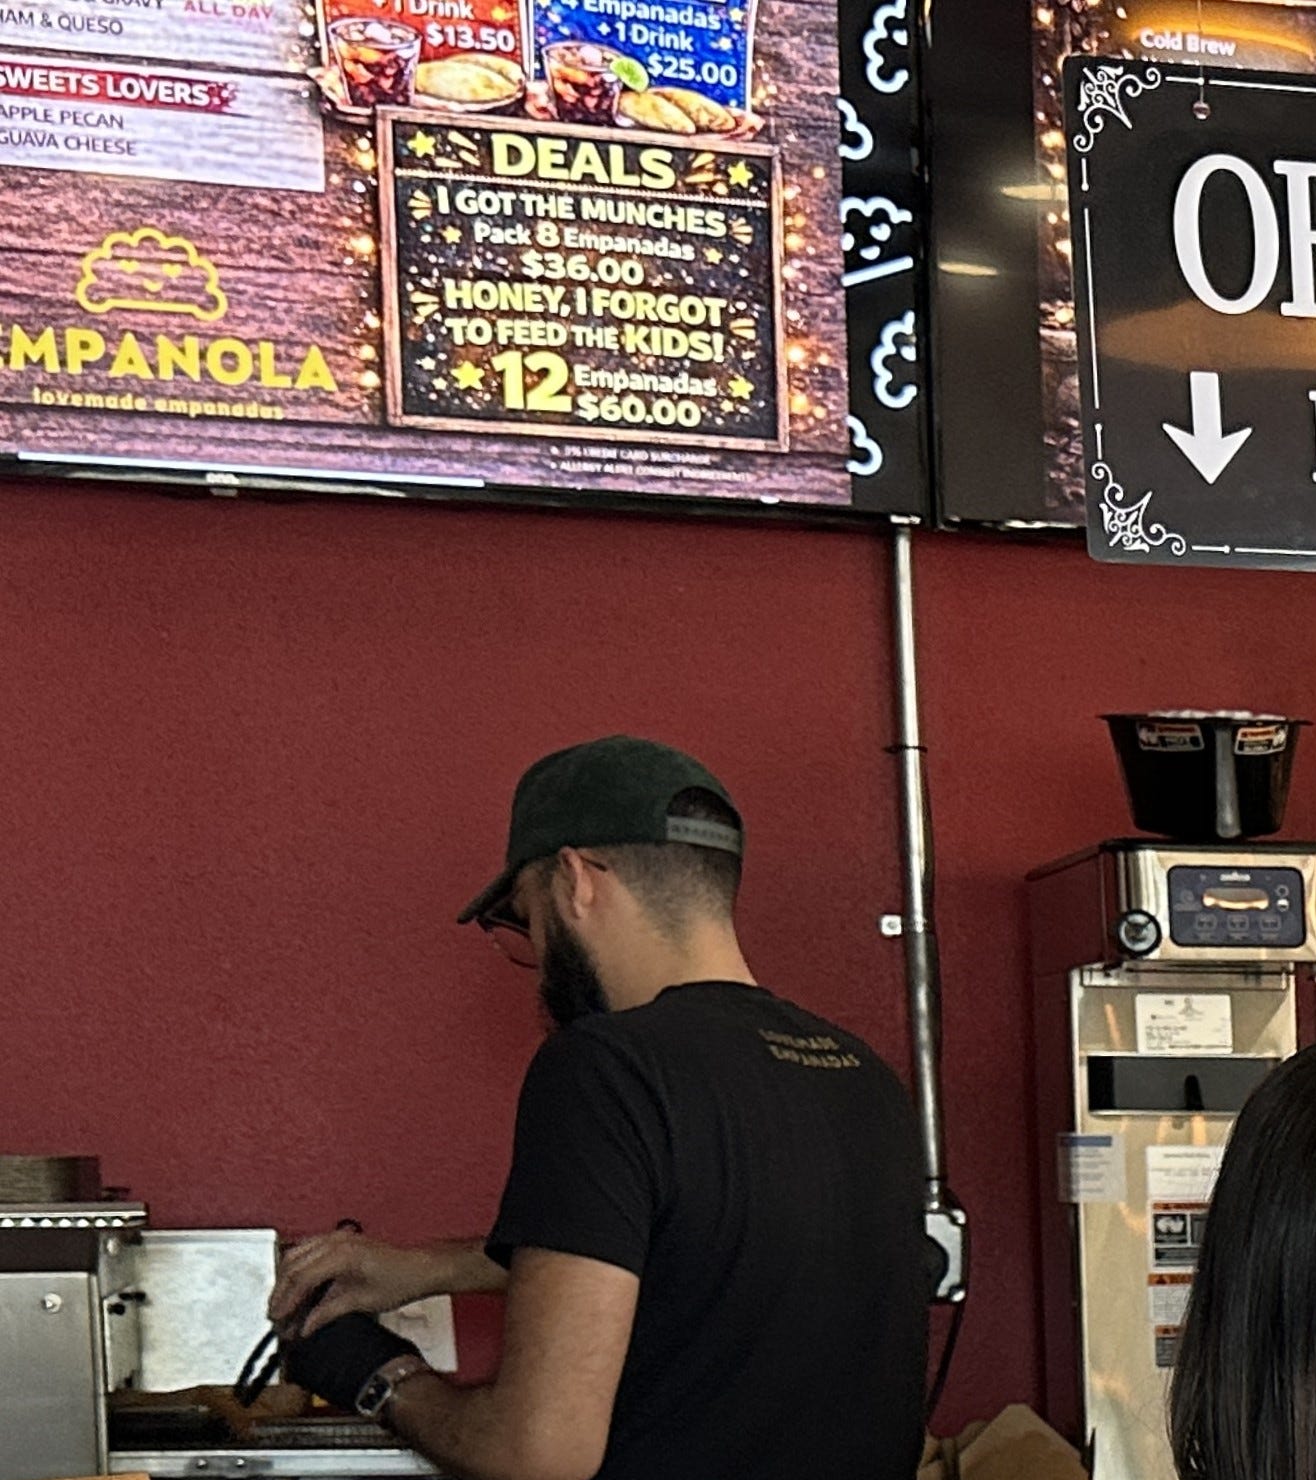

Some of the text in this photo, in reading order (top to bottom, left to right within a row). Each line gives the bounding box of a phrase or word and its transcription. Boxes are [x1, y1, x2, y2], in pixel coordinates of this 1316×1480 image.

[0, 9, 123, 36] AM & QUESO
[412, 0, 473, 20] Drink
[584, 0, 721, 31] Empanadas
[427, 23, 515, 53] $13.50
[631, 25, 693, 51] Drink
[1140, 29, 1236, 57] Cold Brew
[648, 53, 738, 86] $25.00
[106, 73, 210, 106] LOVERS
[60, 110, 124, 130] PECAN
[64, 135, 137, 156] CHEESE
[491, 133, 676, 189] DEALS
[437, 186, 726, 238] I GOT THE MUNCHES
[475, 222, 695, 261] Pack 8 Empanadas
[522, 249, 644, 286] $36.00
[443, 278, 726, 327] HONEY, I FORGOT
[445, 318, 724, 363] TO FEED THE KIDS!
[0, 324, 338, 392] MPANOLA
[492, 351, 716, 412] 12 Empanadas
[578, 397, 701, 428] $60.00
